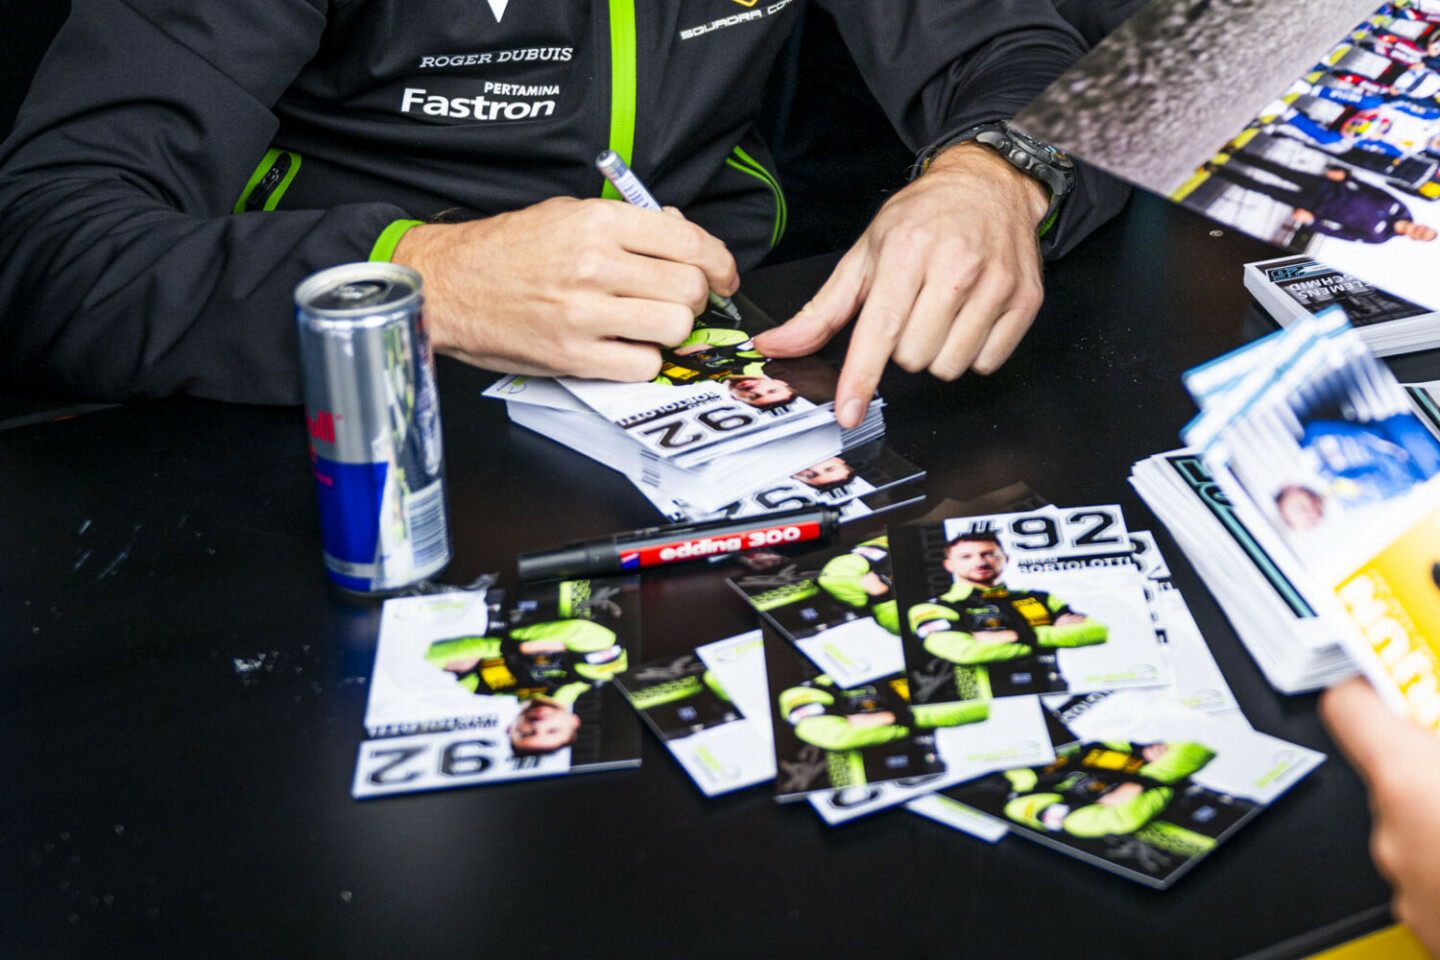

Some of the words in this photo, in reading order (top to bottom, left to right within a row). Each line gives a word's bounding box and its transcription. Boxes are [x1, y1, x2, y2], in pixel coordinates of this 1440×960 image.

[680, 9, 762, 40] SQUADRA
[419, 52, 493, 69] ROGER
[496, 46, 574, 64] DUBUIS
[400, 87, 557, 121] Fastron
[484, 81, 560, 97] PERTAMINA
[659, 535, 741, 562] edding
[748, 526, 801, 547] 300
